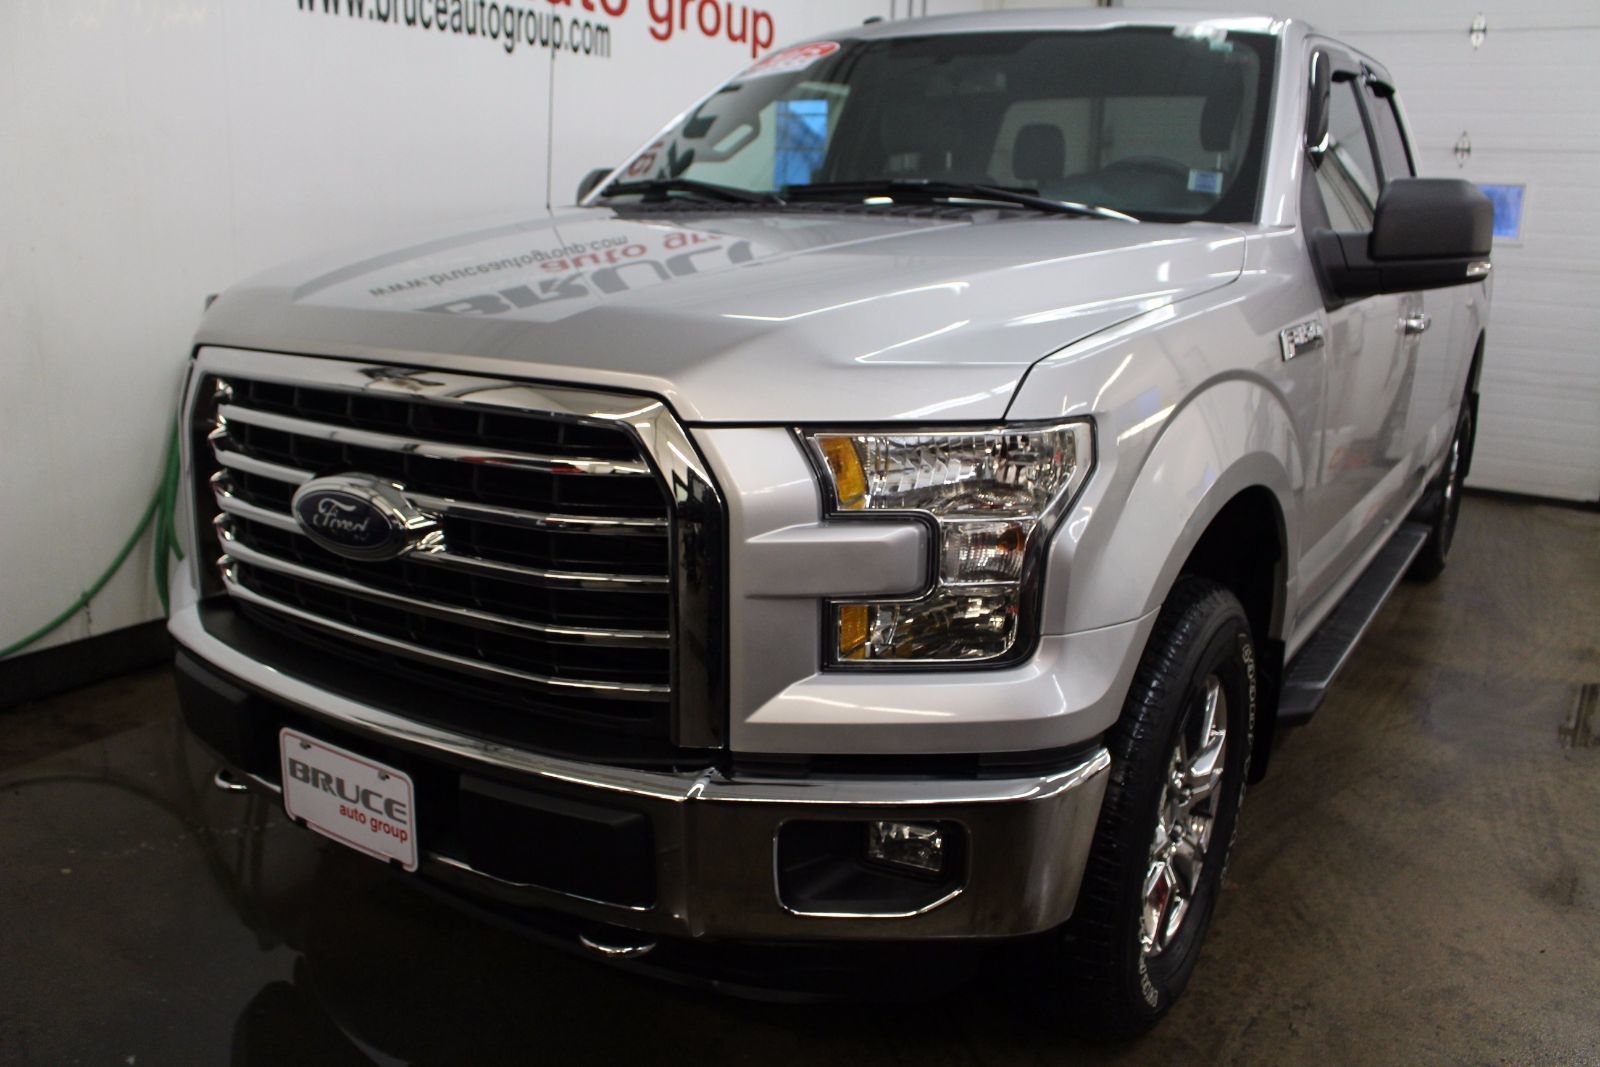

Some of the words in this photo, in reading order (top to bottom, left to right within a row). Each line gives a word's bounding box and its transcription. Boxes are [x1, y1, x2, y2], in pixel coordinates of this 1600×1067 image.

[297, 0, 612, 59] w.bruceautogroup.com
[648, 0, 775, 59] group
[312, 497, 370, 532] Ford
[288, 757, 408, 826] BRUCE
[339, 803, 367, 825] auto
[370, 816, 408, 844] group
